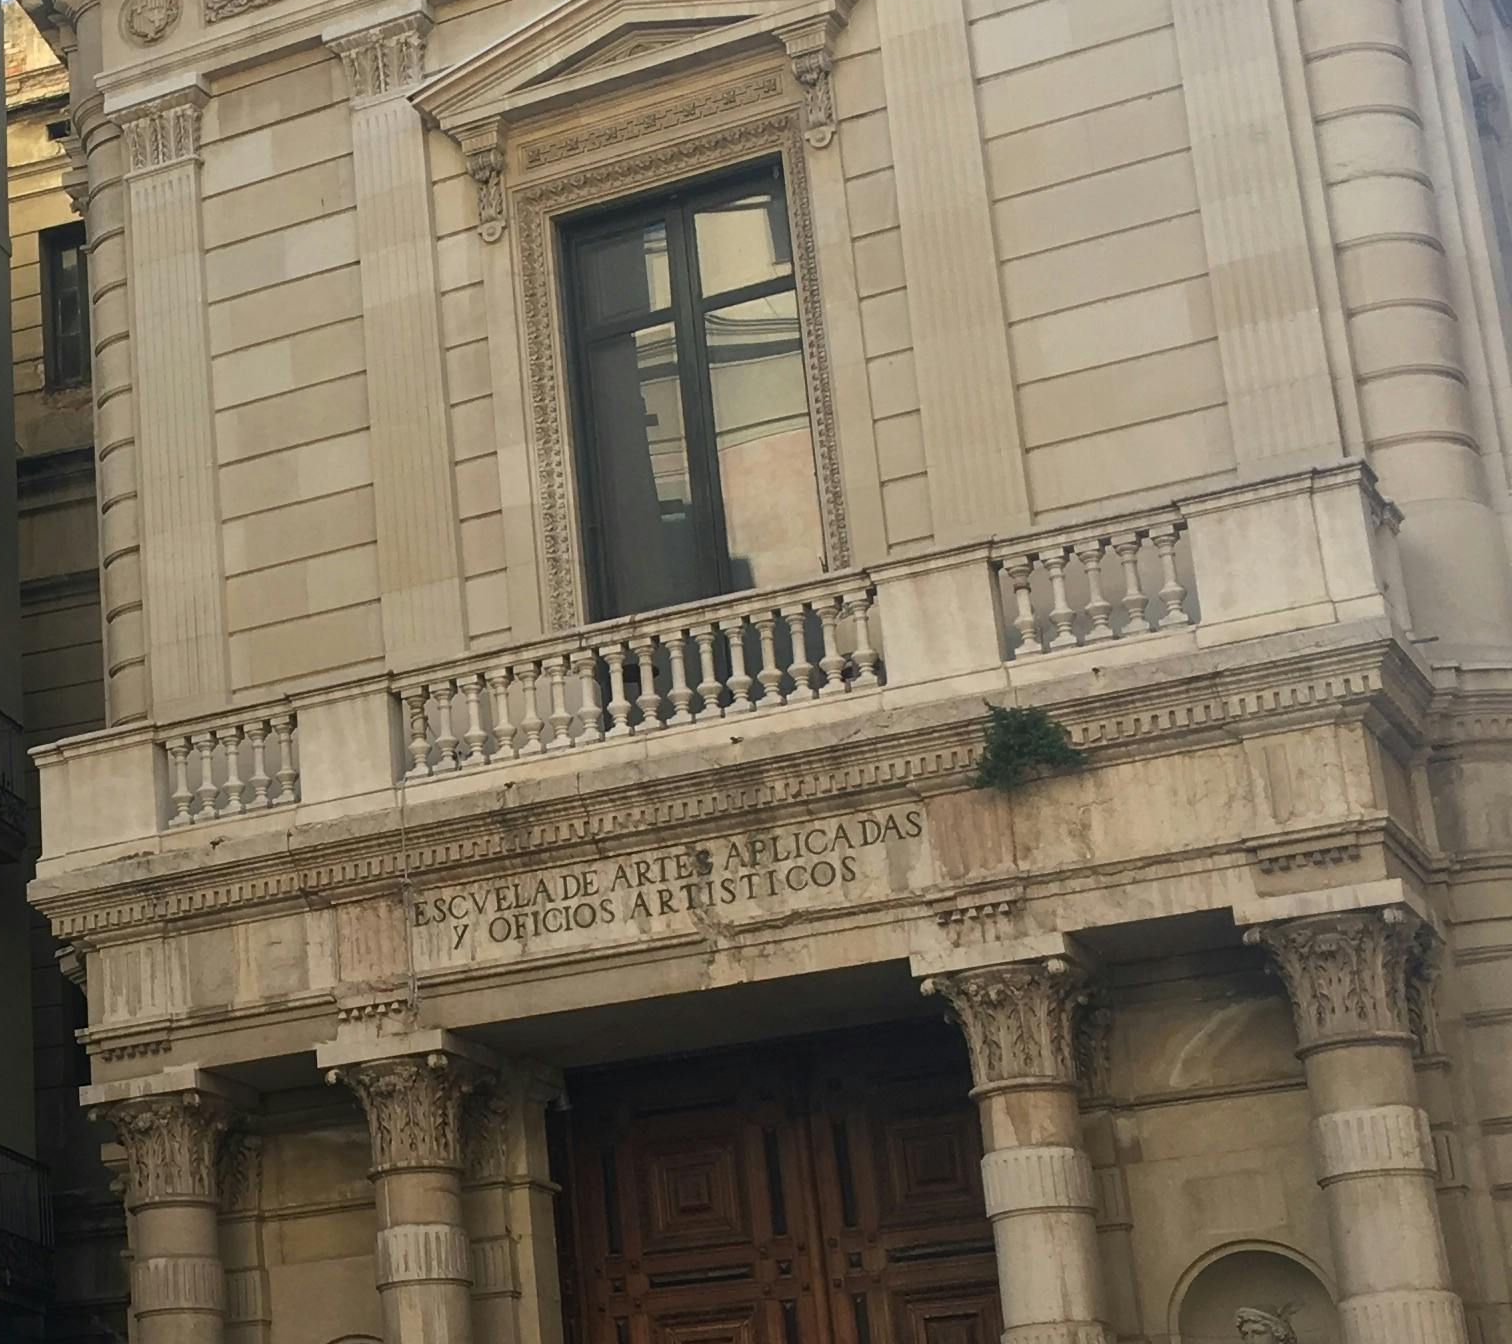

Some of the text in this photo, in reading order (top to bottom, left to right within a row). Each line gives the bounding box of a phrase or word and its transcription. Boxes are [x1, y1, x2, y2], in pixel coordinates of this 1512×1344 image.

[489, 898, 616, 944] OFICIOS
[629, 855, 857, 920] ARTISTICOS
[560, 869, 600, 901] DE
[610, 848, 714, 892] ARTES
[723, 810, 923, 872] APLICADAS
